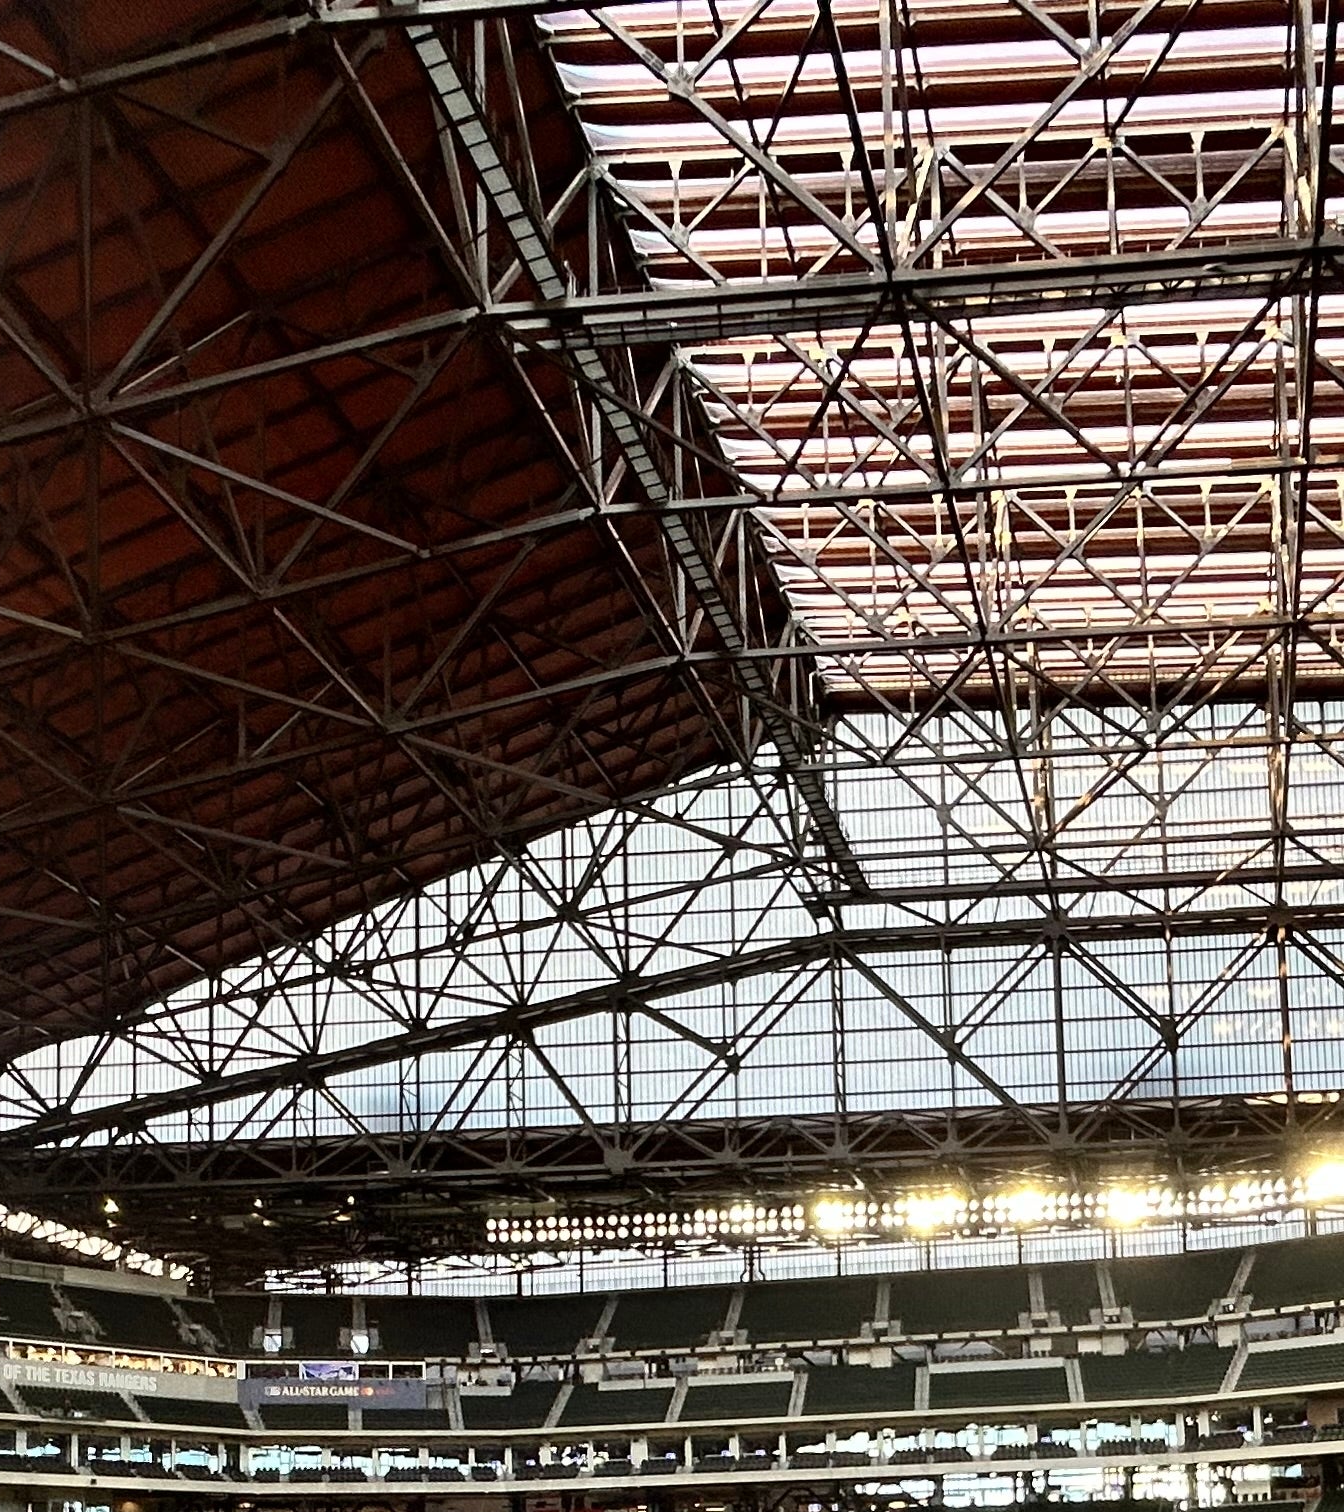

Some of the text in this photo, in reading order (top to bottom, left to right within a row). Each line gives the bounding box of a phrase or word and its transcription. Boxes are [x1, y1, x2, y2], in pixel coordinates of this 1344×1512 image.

[3, 1363, 21, 1380] OF
[25, 1365, 51, 1382] THE
[55, 1368, 95, 1387] TEXAS
[98, 1372, 157, 1391] RANGERS
[329, 1386, 359, 1396] GAME
